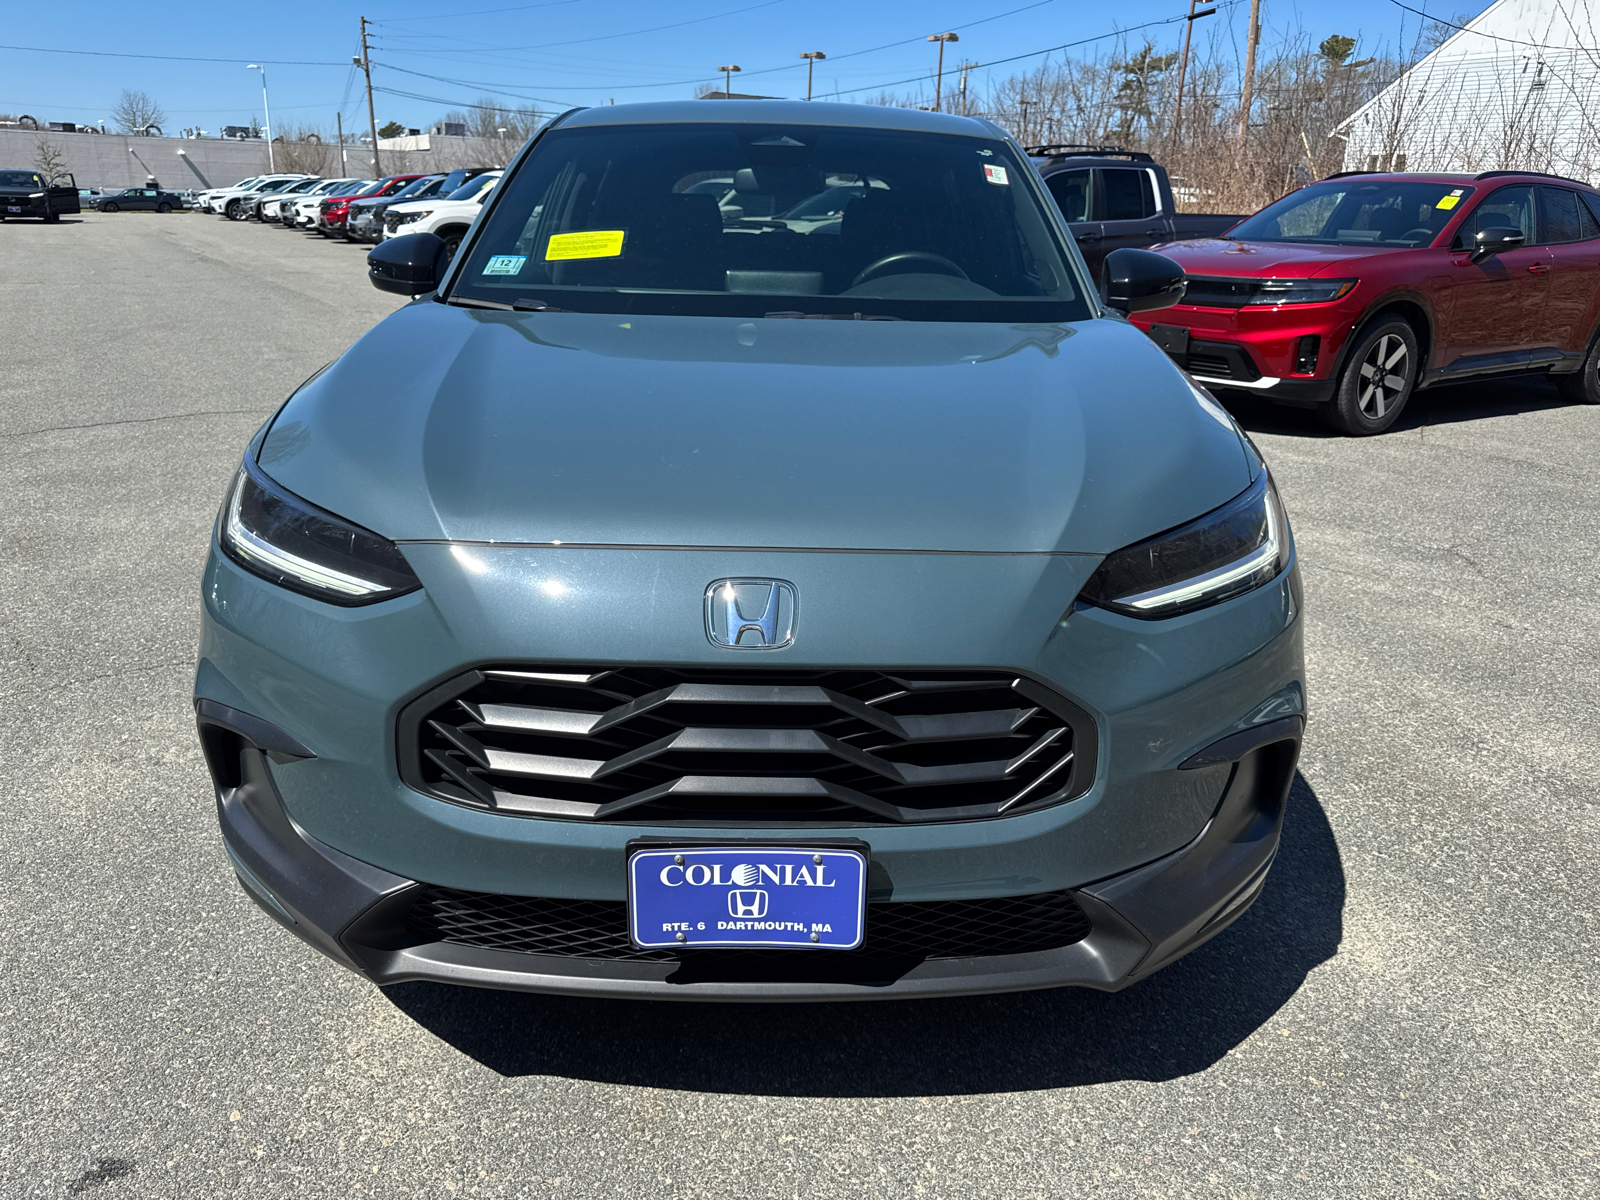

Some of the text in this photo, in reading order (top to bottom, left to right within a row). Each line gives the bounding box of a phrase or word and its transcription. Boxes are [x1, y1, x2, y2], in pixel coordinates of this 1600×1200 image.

[500, 259, 512, 267] 12
[659, 863, 836, 888] COLONIAL
[662, 921, 833, 933] RTE. 6 DARTMOUTH, MA
